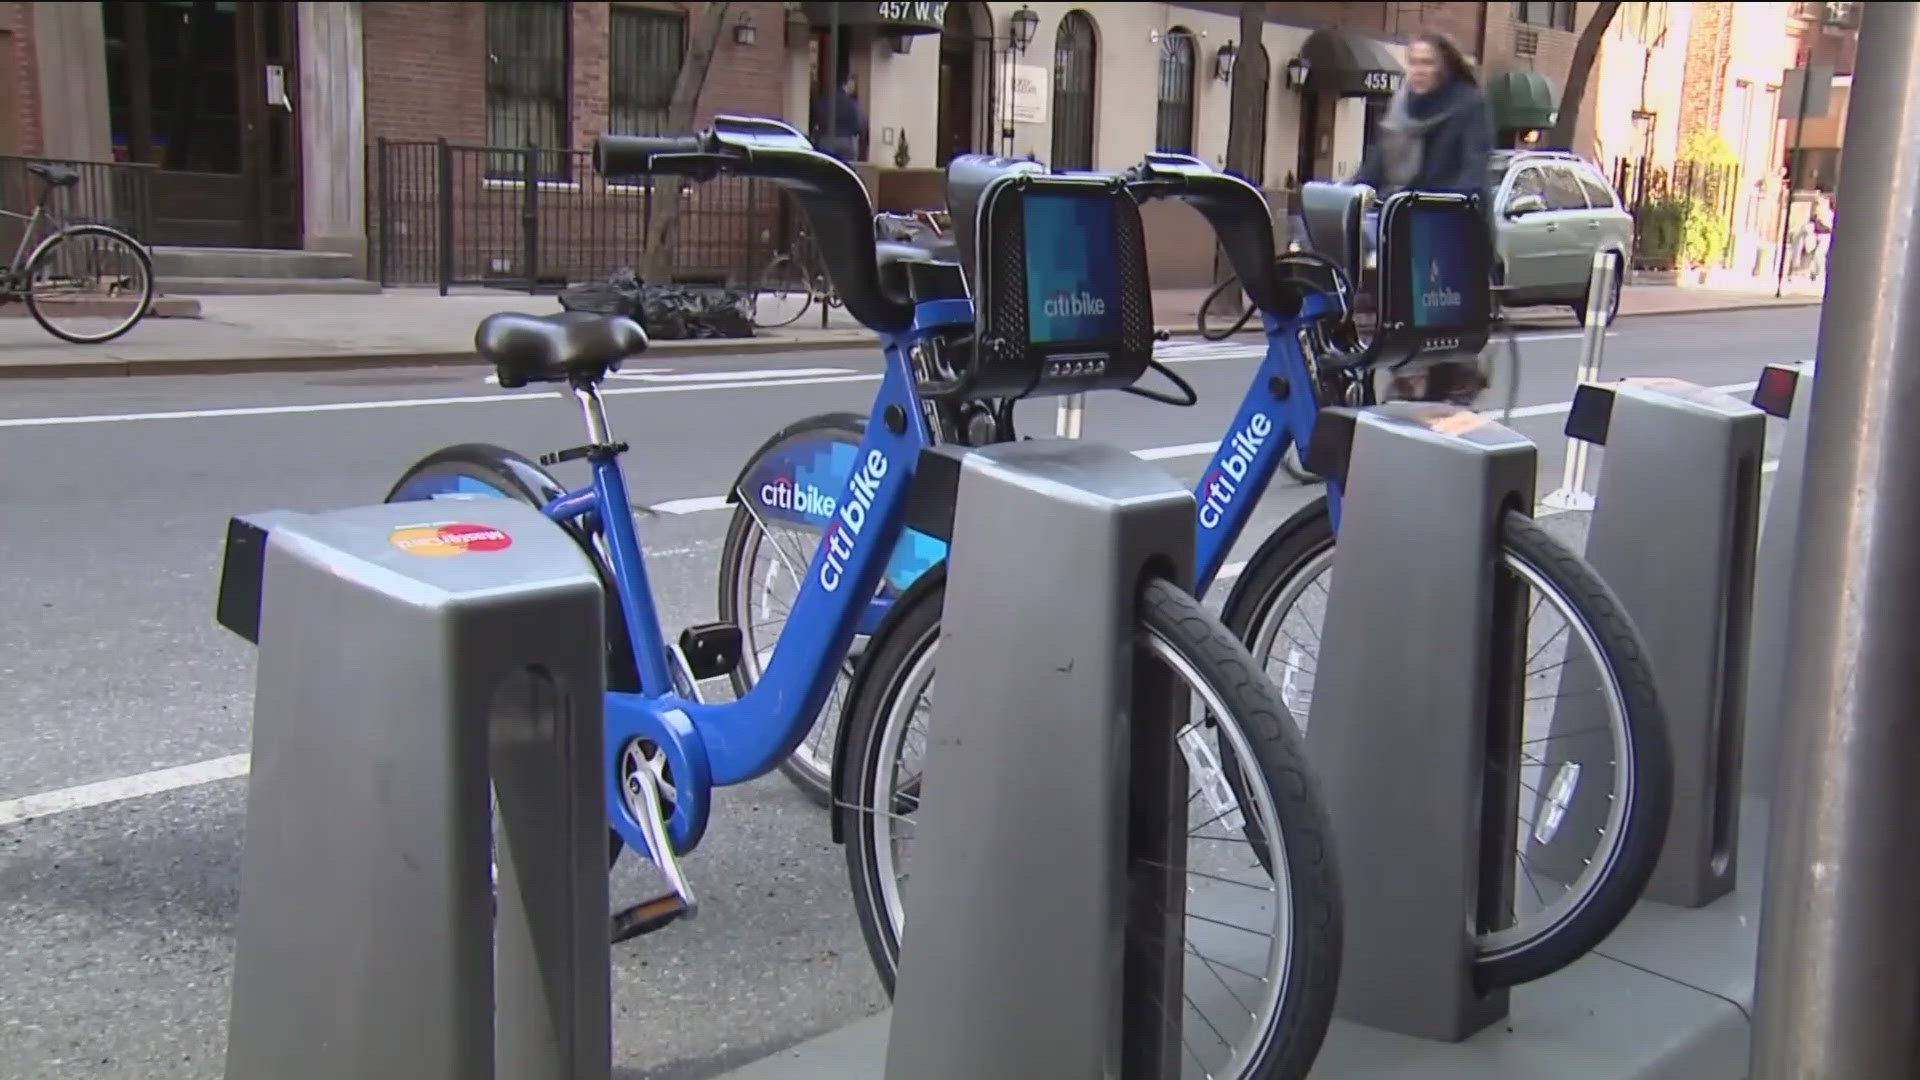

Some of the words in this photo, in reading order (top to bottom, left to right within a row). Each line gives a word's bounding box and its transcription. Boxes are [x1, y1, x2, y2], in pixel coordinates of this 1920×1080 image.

[879, 2, 910, 19] 457
[1364, 73, 1387, 89] 455
[1044, 292, 1069, 317] citi
[1072, 291, 1105, 317] bike
[1199, 473, 1235, 529] citi
[1220, 412, 1272, 482] bike
[761, 479, 792, 509] citi
[794, 483, 836, 518] bike
[820, 522, 854, 592] citi
[840, 449, 888, 536] bike
